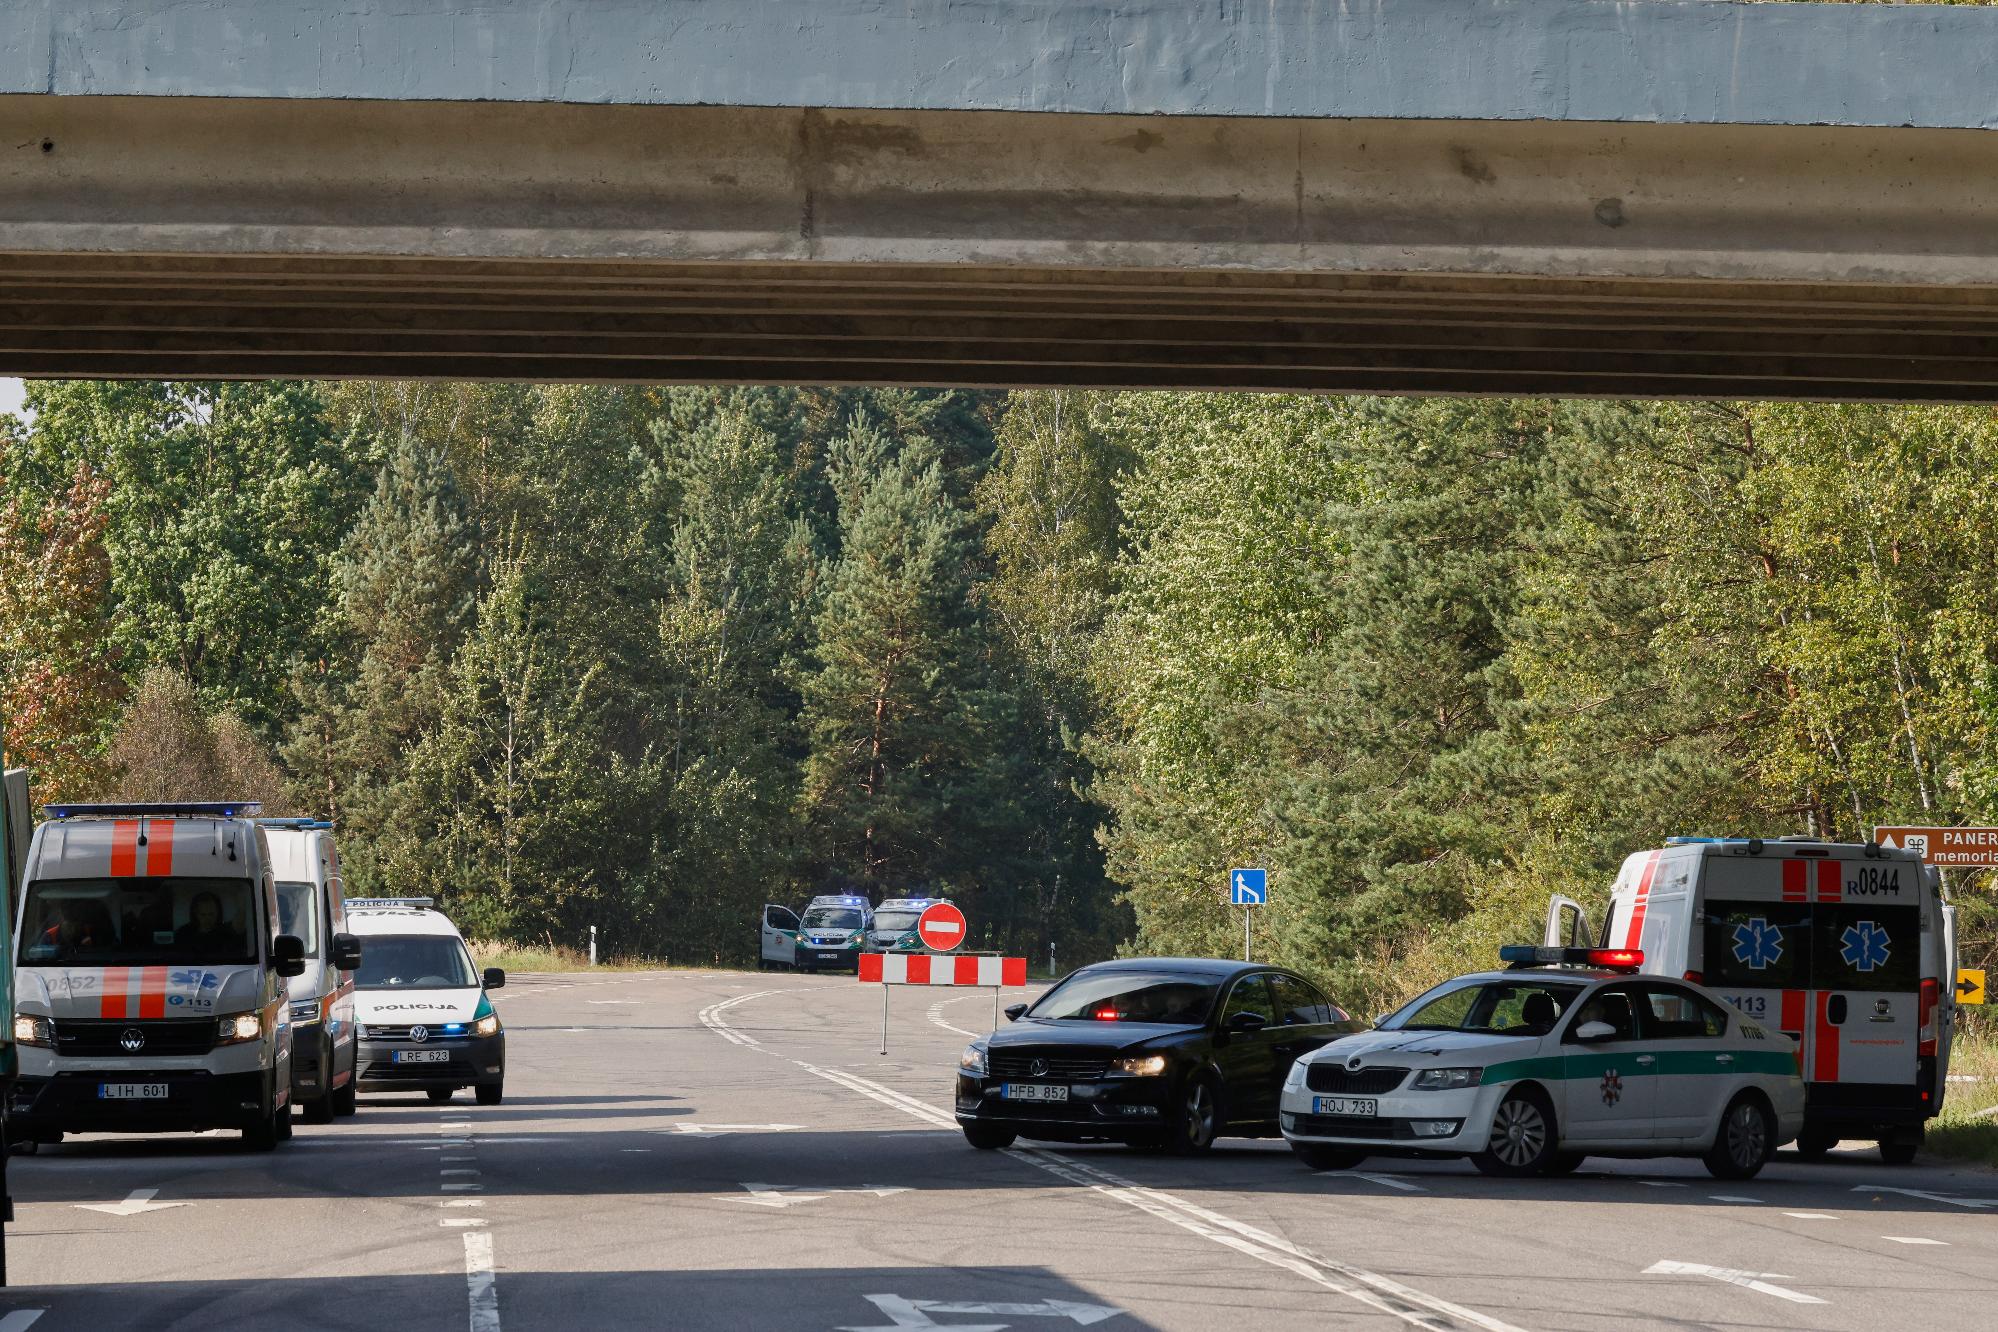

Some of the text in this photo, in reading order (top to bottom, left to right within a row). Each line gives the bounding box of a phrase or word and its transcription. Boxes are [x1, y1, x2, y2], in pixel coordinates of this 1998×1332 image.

[187, 998, 212, 1006] 113
[373, 1004, 458, 1012] POLICIJA
[1734, 996, 1766, 1012] 113
[400, 1051, 448, 1062] LRE 623
[106, 1085, 166, 1097] LIH 601
[1010, 1085, 1066, 1100] HFB 852
[1320, 1099, 1373, 1114] HOJ 733
